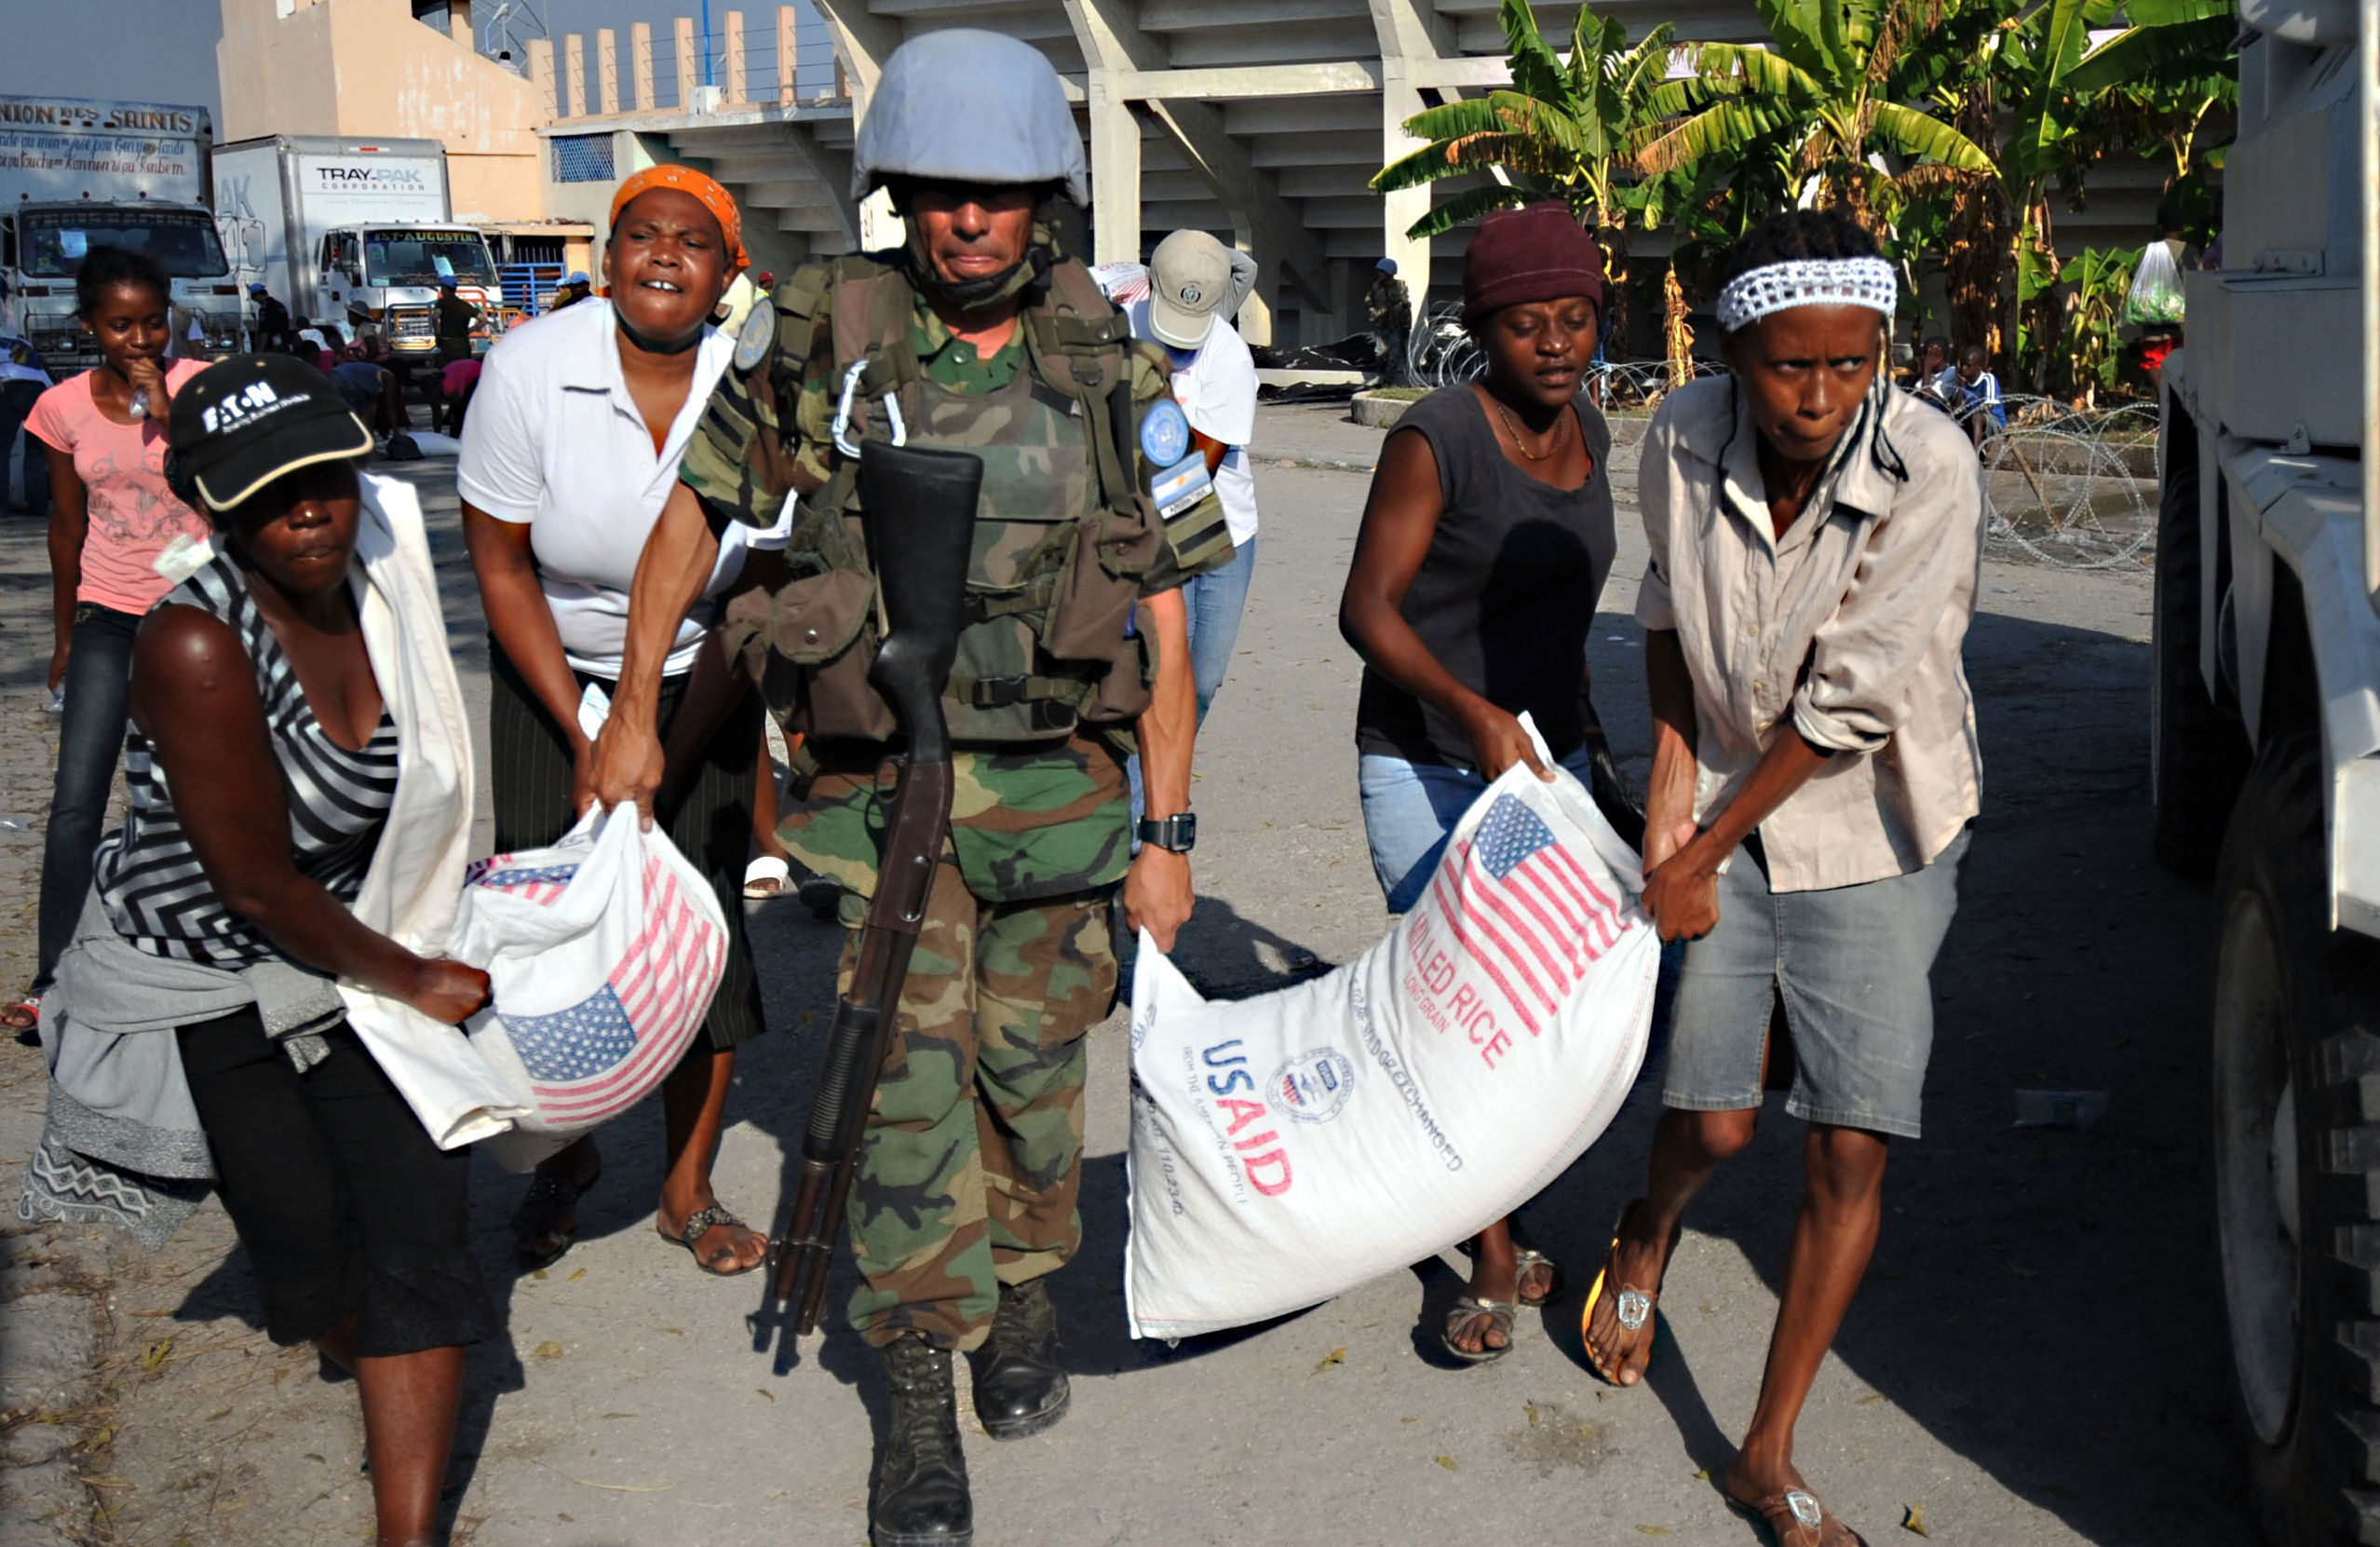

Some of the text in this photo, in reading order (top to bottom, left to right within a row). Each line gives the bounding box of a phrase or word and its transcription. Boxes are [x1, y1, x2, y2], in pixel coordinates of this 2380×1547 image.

[61, 106, 101, 119] DES
[111, 109, 194, 134] SAINTS
[317, 168, 421, 182] TRAY-PAK
[321, 182, 425, 190] CORPORATION
[1403, 971, 1450, 1034] LONG GRAIN
[1407, 911, 1513, 1071] MILLED RICE
[1183, 1046, 1196, 1074] FROM
[1186, 1075, 1201, 1093] THE
[1202, 1038, 1292, 1197] USAID
[1224, 1155, 1249, 1207] PEOPLE
